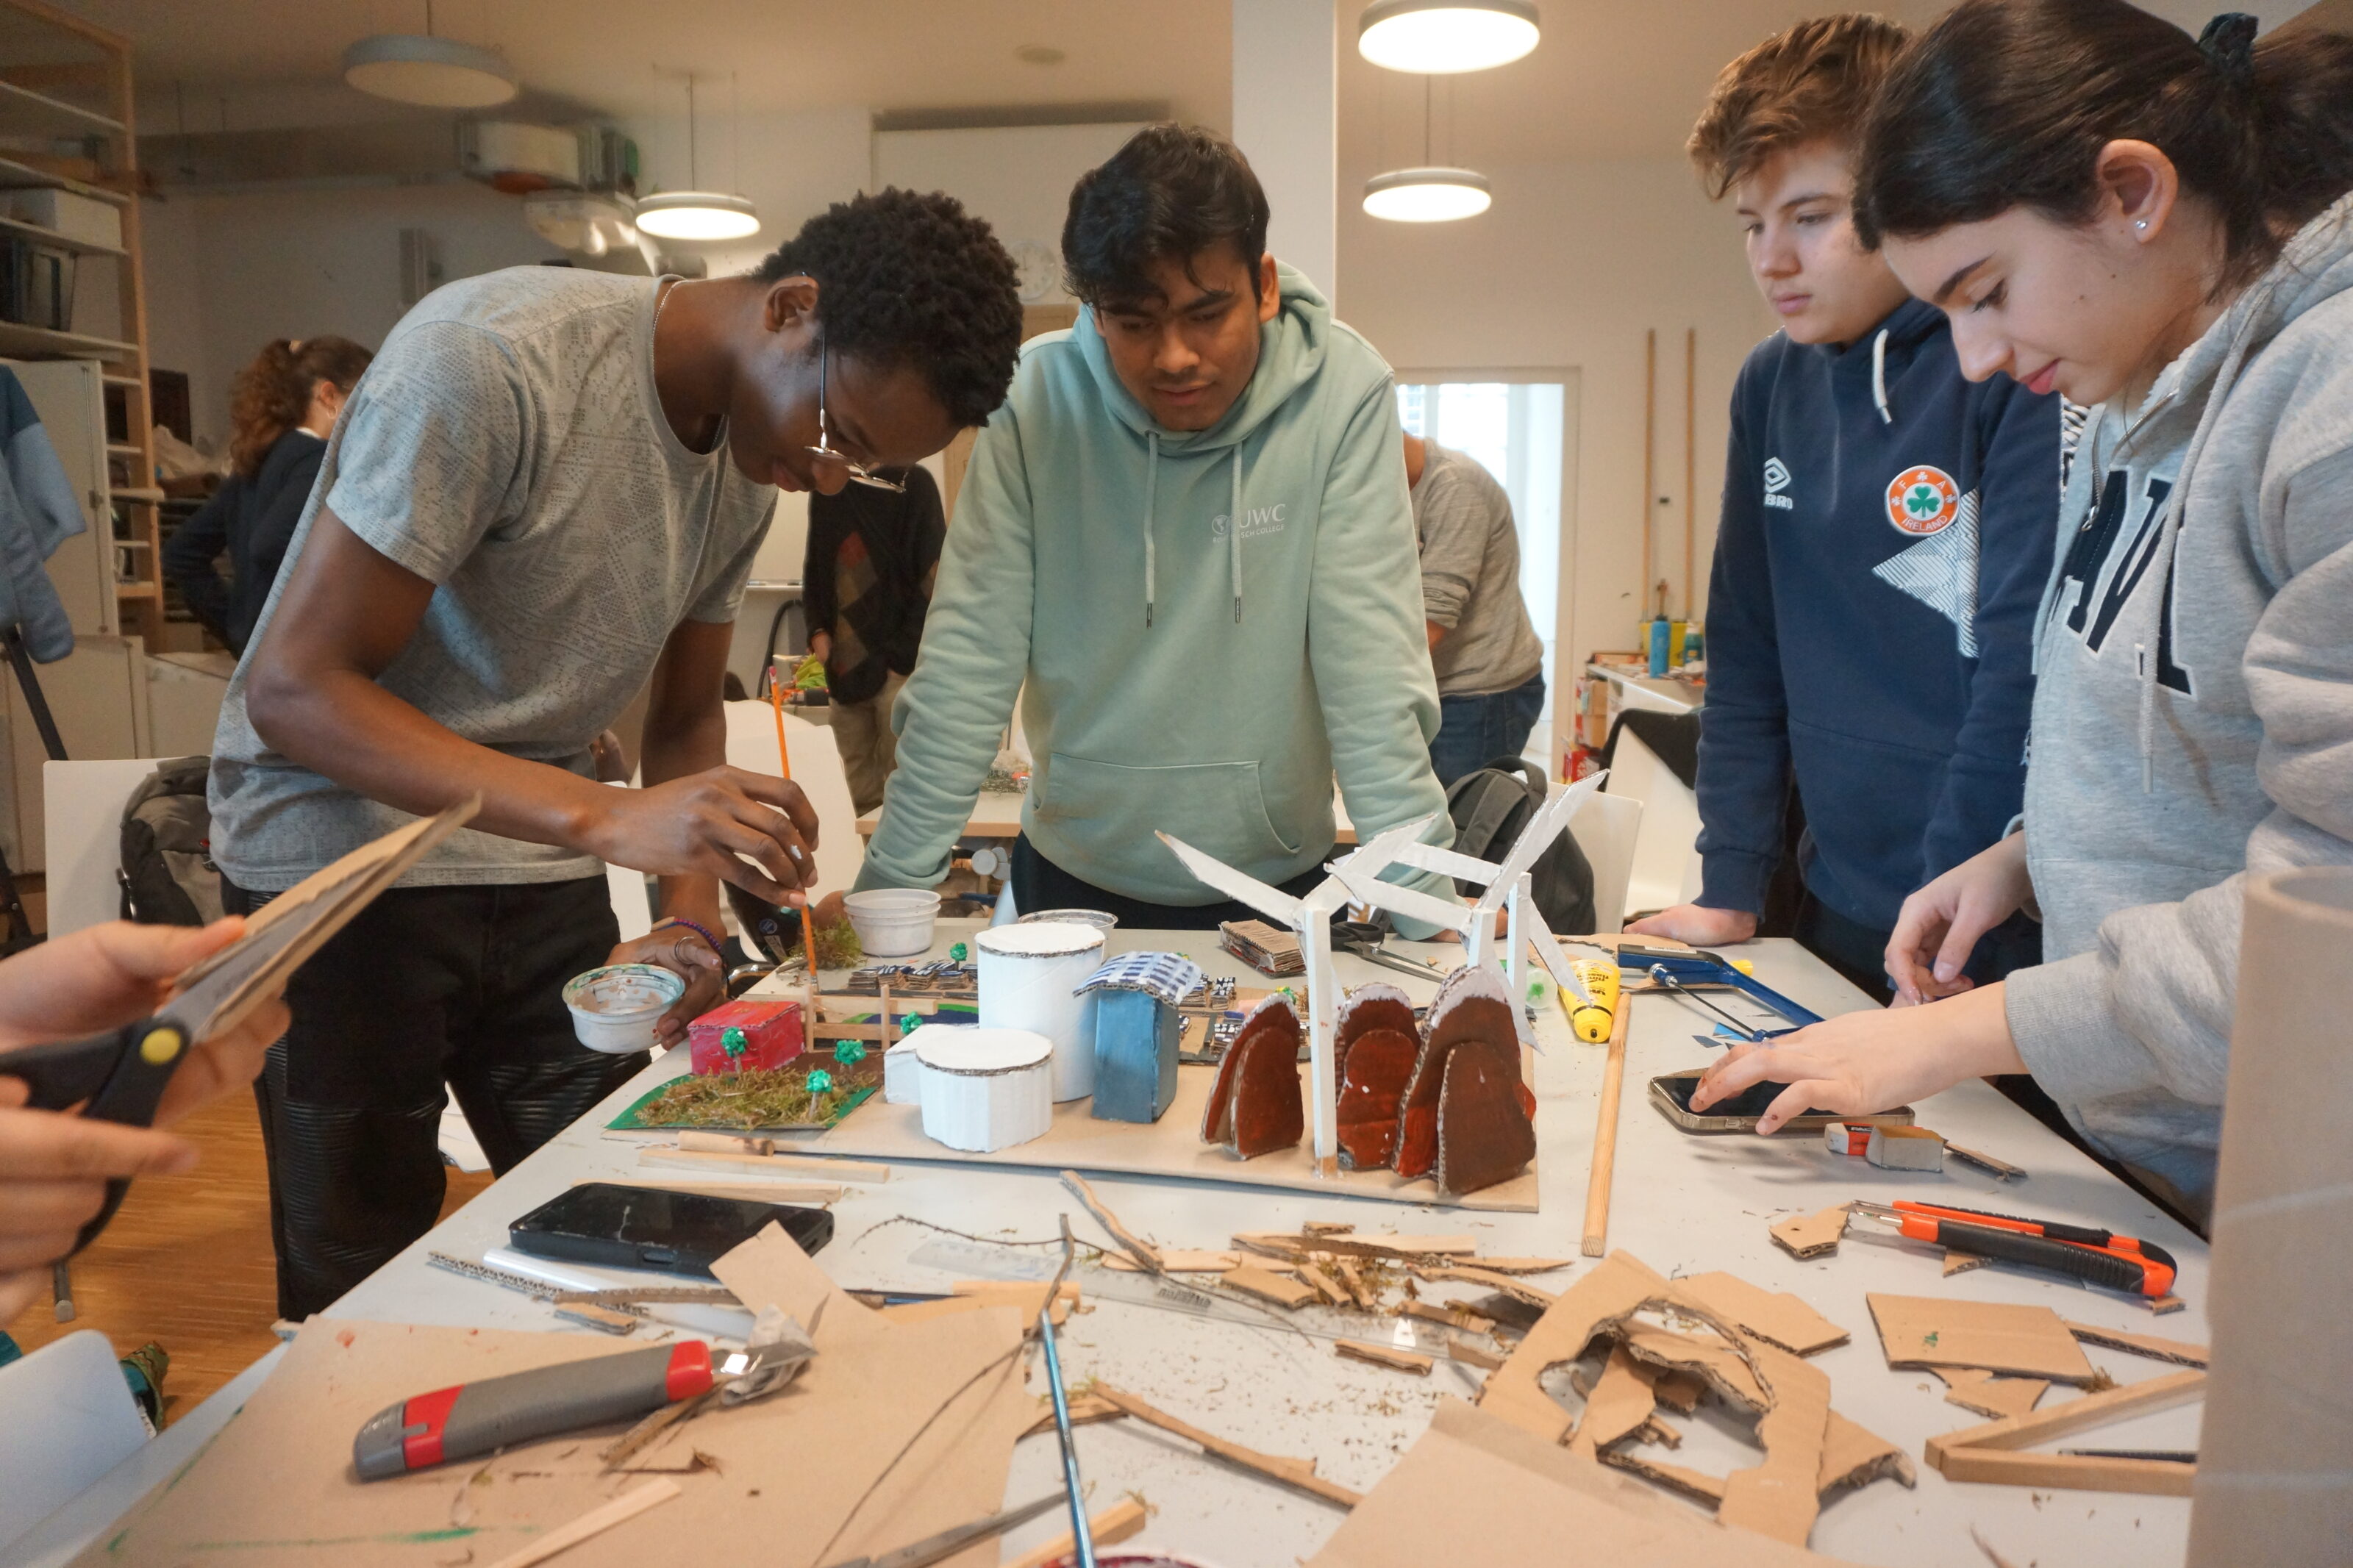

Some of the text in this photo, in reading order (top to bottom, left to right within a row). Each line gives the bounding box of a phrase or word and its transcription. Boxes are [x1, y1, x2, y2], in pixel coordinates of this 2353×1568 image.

[1239, 504, 1285, 528] UWC
[1902, 515, 1948, 531] IRELAND
[1256, 524, 1285, 535] COLLEGE
